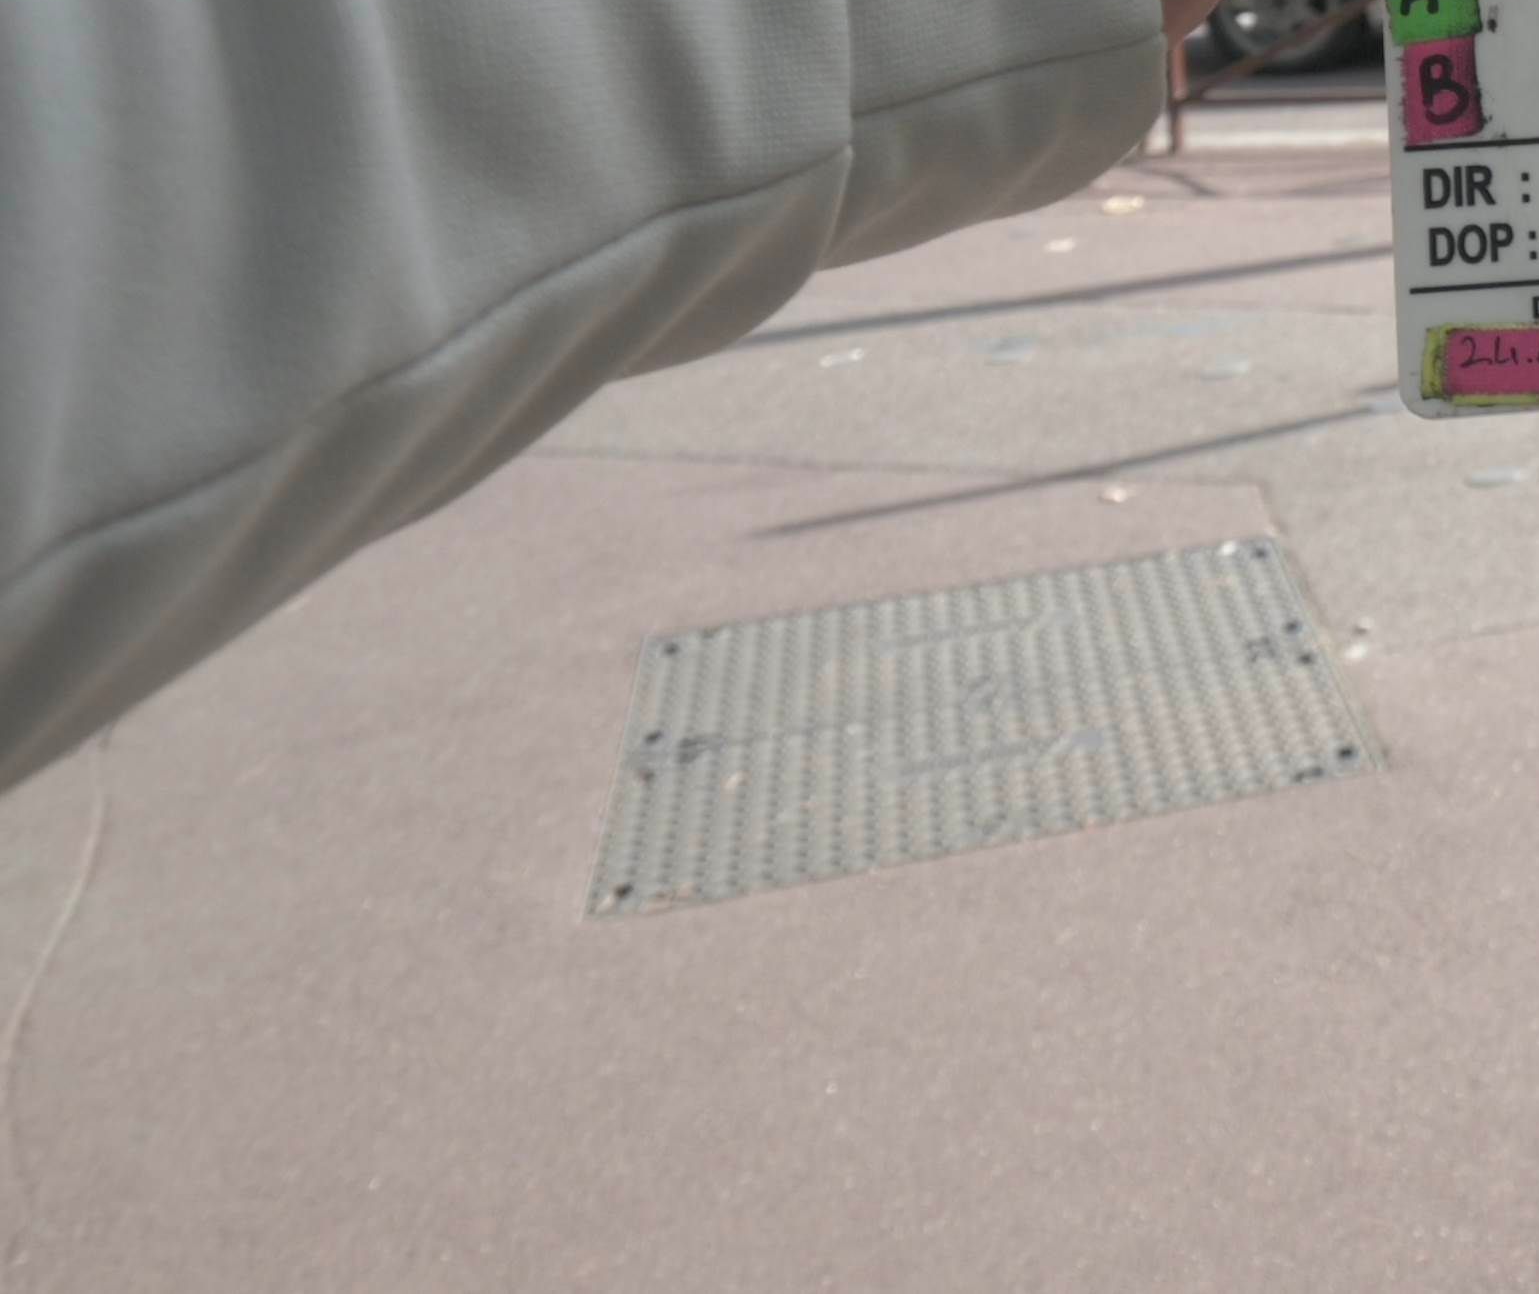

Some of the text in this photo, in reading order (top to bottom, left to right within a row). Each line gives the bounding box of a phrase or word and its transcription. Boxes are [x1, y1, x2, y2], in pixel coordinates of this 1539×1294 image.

[1419, 54, 1469, 126] B
[1422, 165, 1496, 209] DIR
[1429, 223, 1514, 267] DOP
